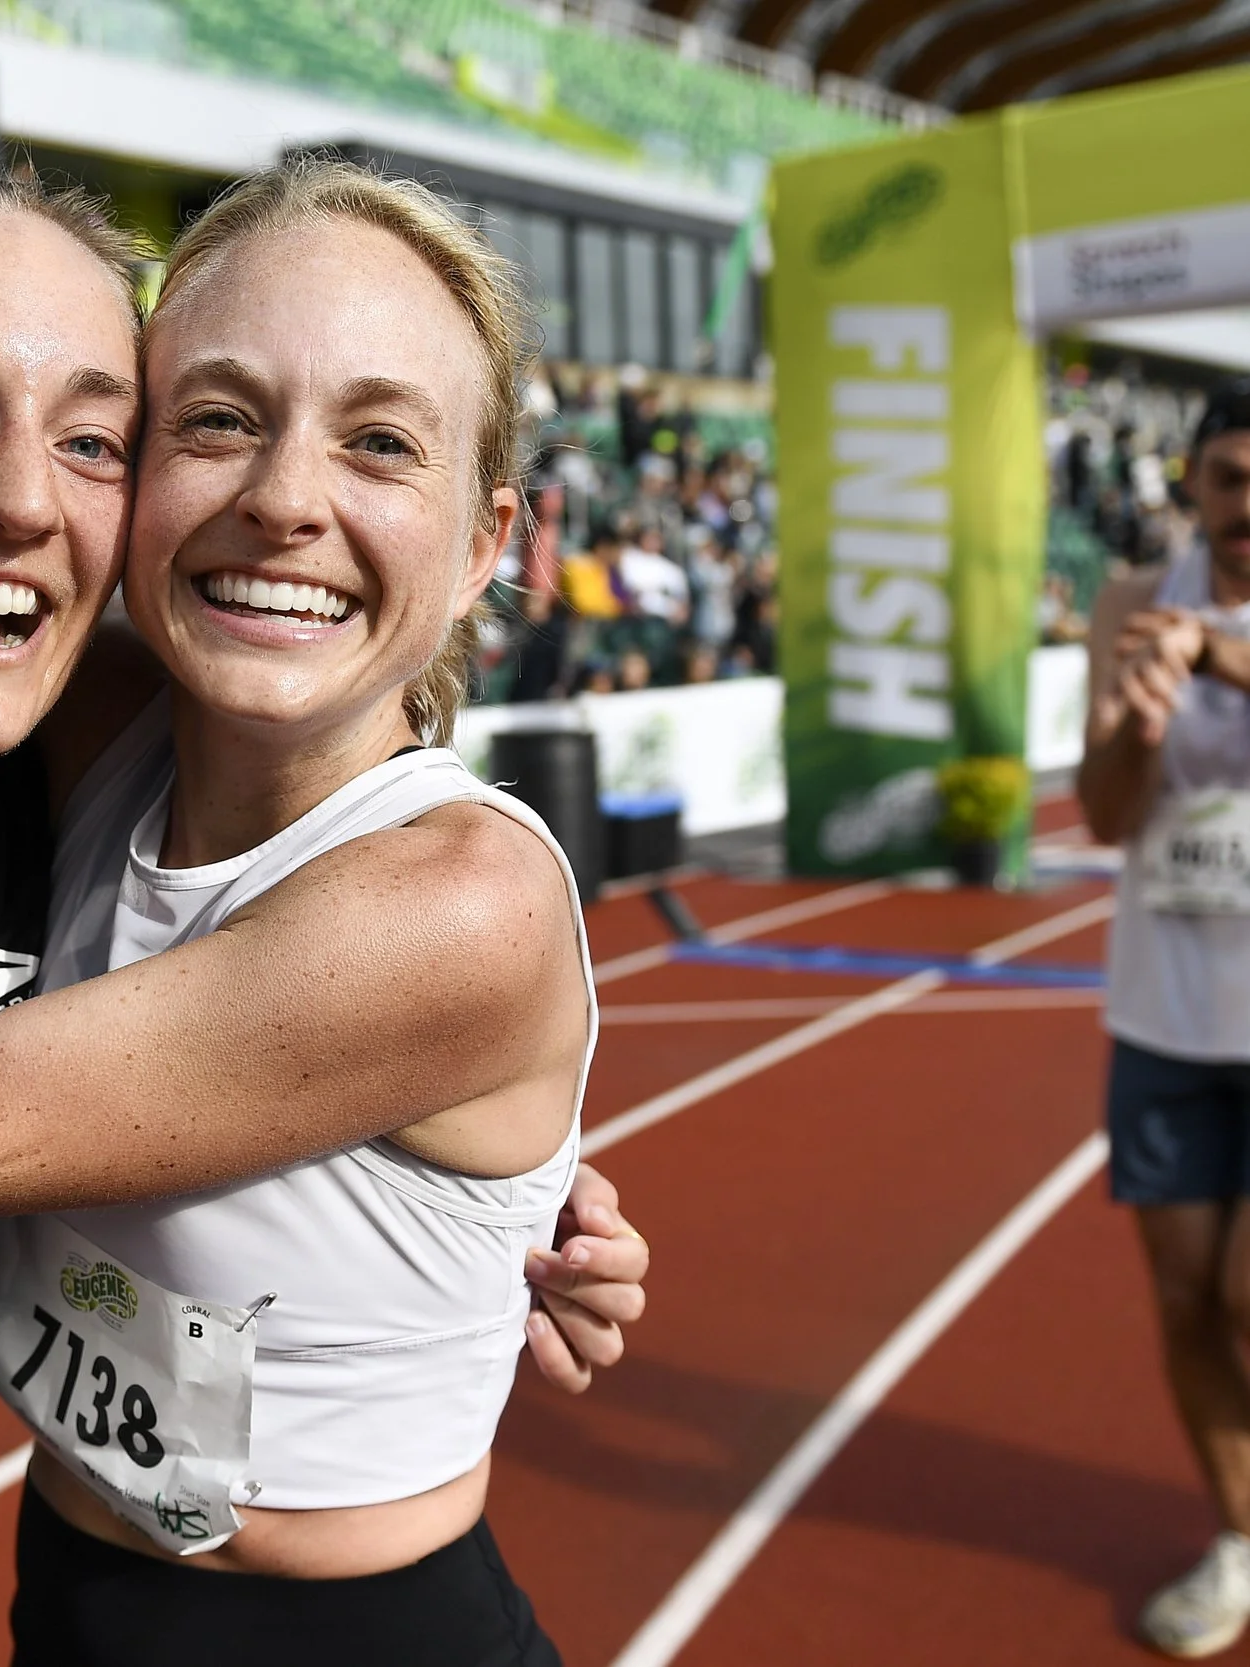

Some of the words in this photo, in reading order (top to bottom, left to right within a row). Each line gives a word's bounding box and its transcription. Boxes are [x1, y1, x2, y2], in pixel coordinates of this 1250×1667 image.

[830, 306, 953, 742] FINISH
[73, 1274, 127, 1303] EUGENE
[181, 1305, 211, 1319] CORRAL
[189, 1321, 204, 1338] B
[11, 1305, 165, 1469] 7138
